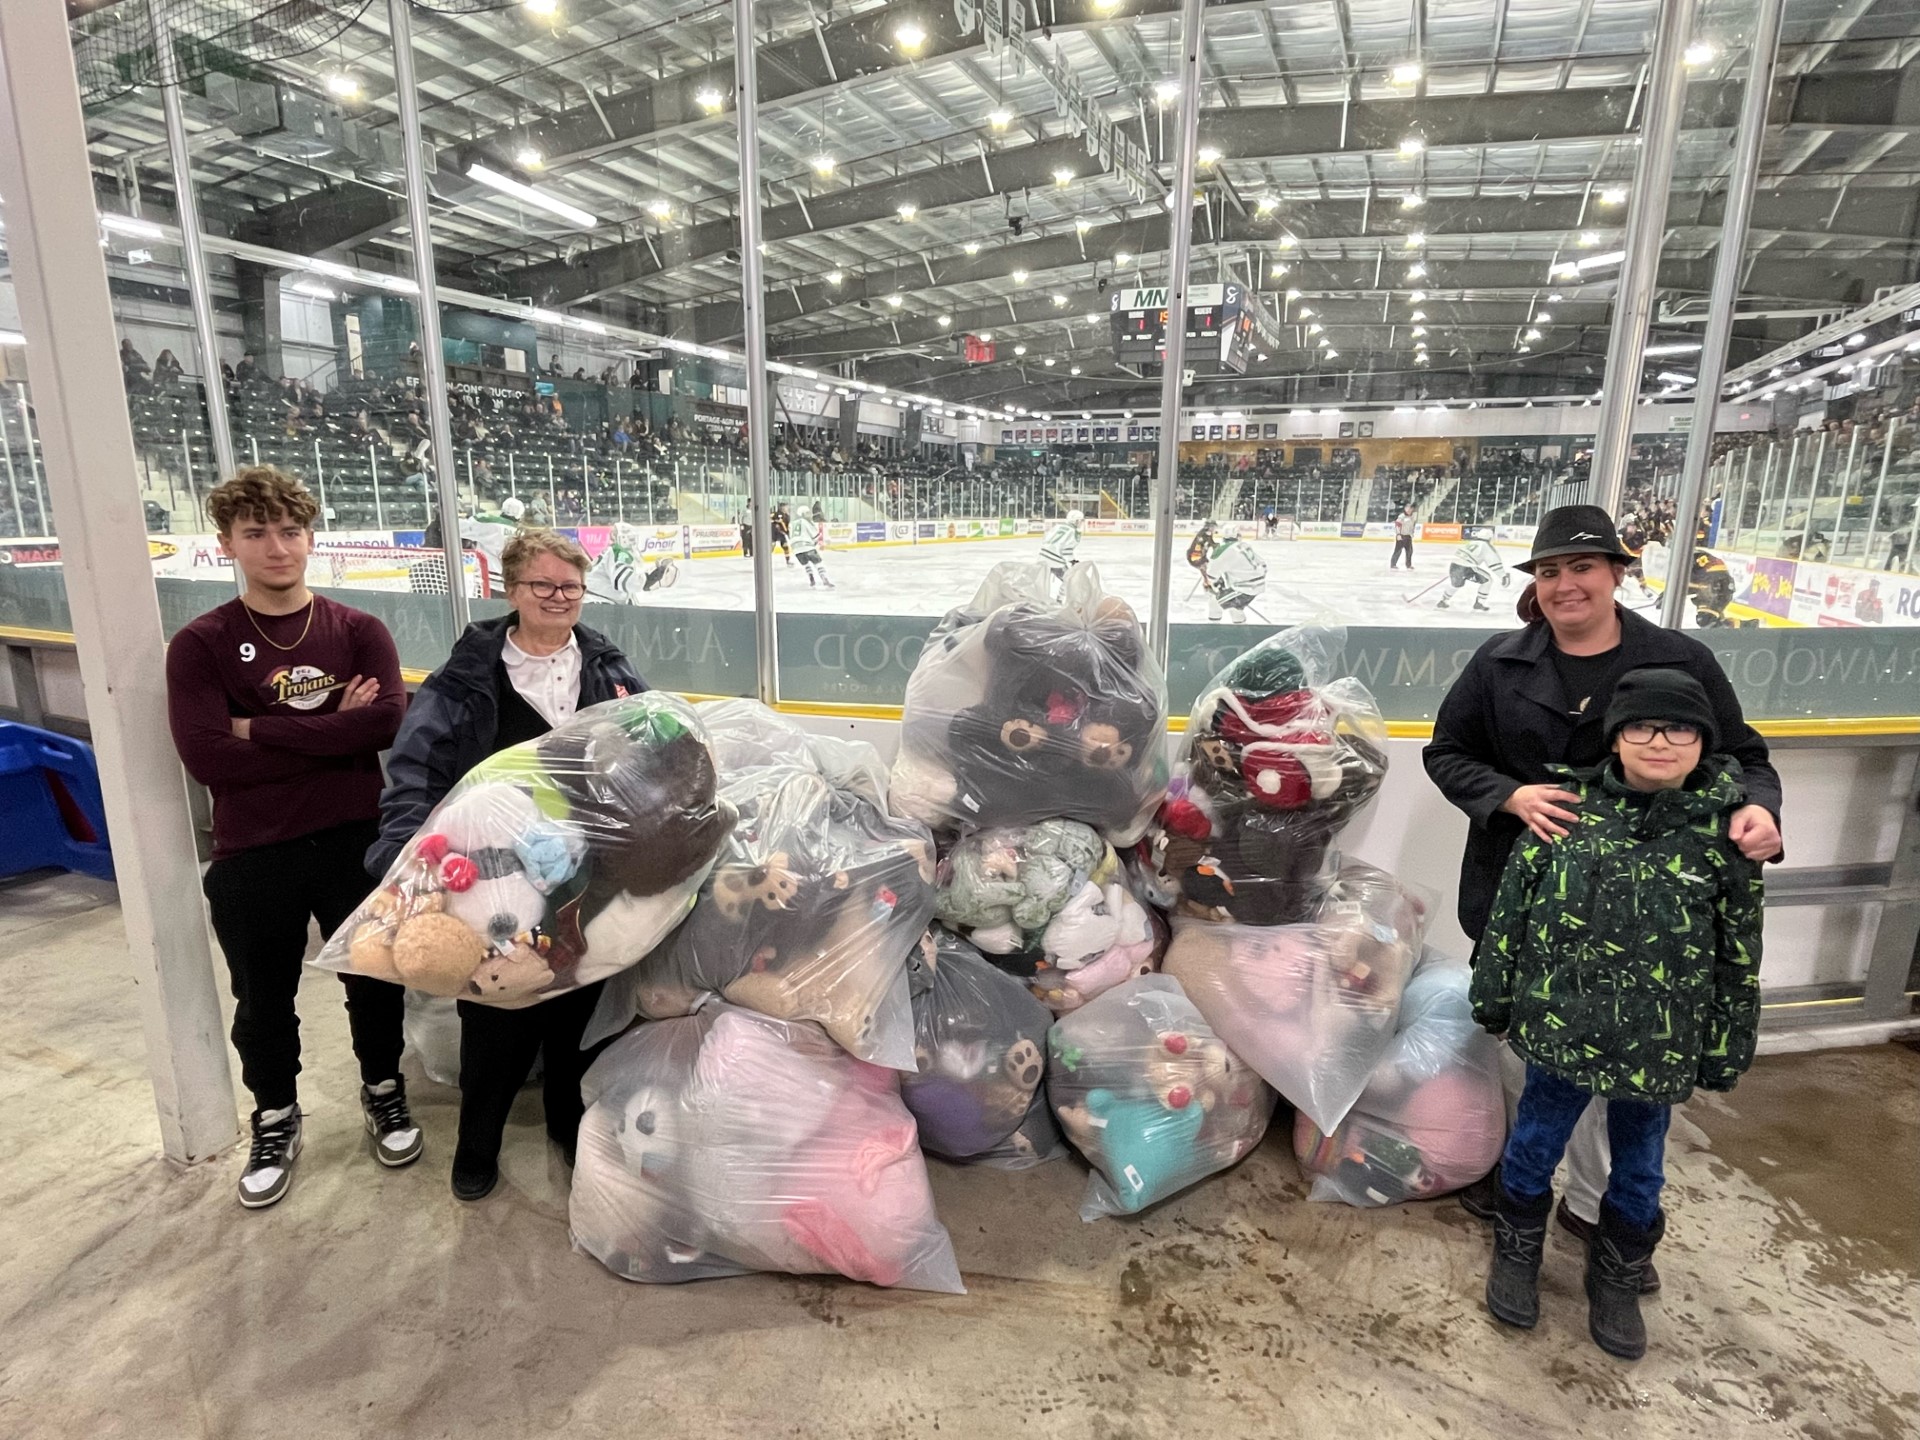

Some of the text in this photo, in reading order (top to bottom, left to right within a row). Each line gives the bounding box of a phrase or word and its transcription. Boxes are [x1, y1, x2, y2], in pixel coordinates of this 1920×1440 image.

[1133, 289, 1169, 307] MN
[239, 643, 256, 662] 9
[270, 674, 336, 702] Trojans
